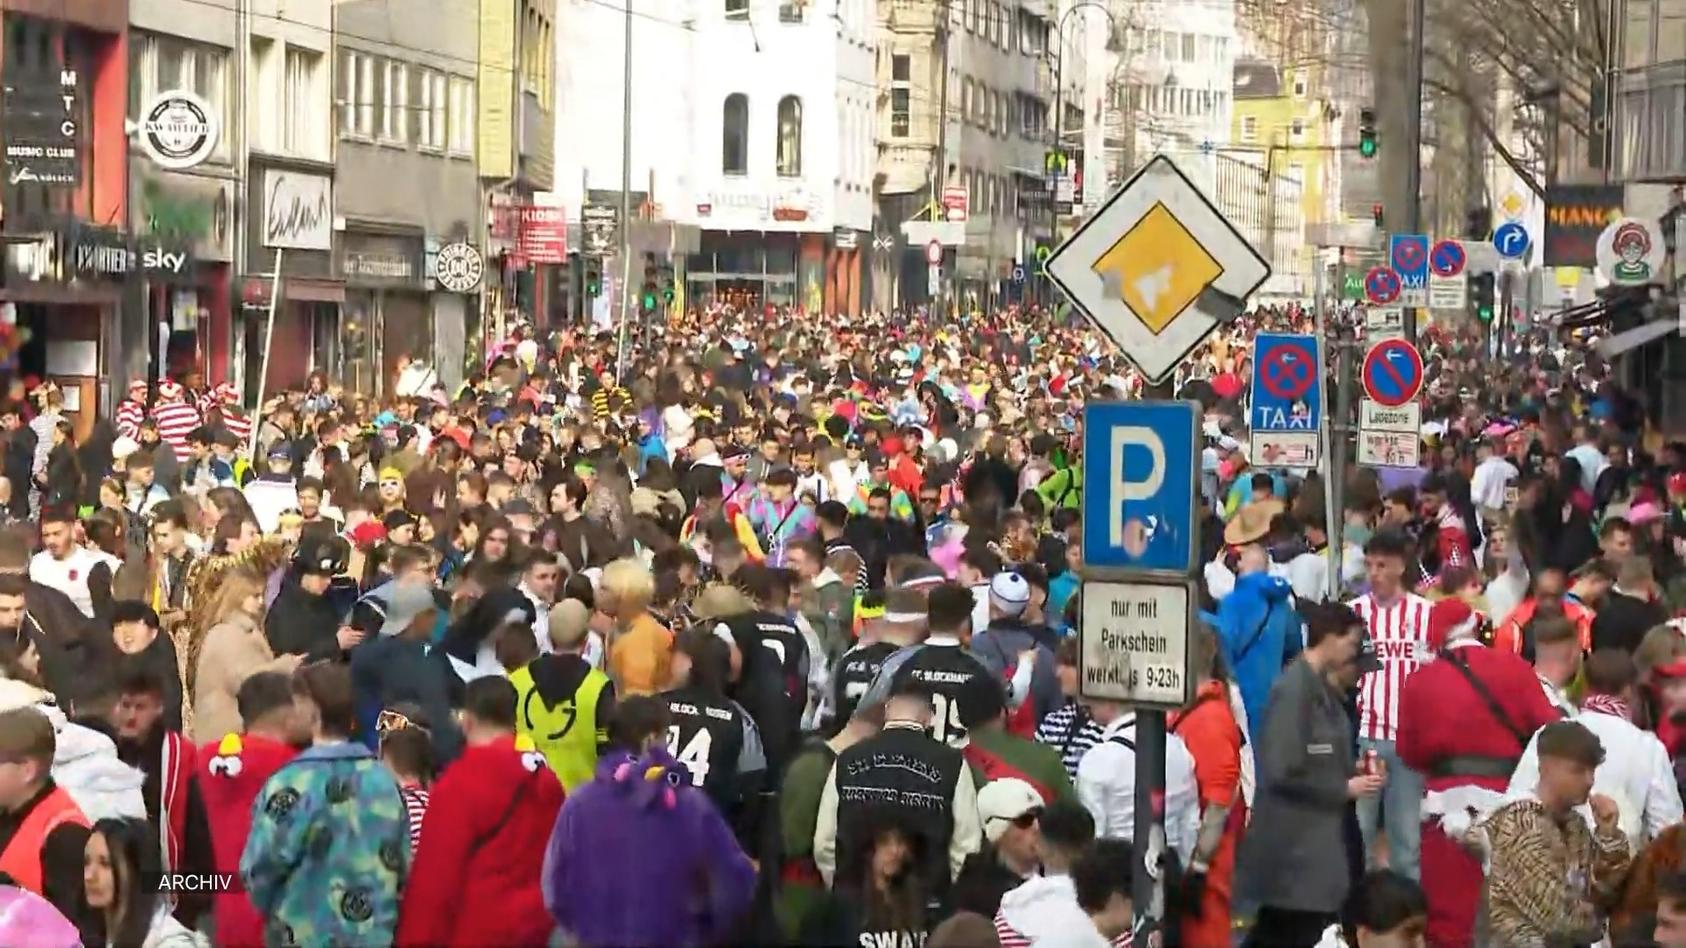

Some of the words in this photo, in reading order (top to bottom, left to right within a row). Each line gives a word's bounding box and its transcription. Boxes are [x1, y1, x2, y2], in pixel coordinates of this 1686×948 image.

[143, 248, 186, 273] sky
[1401, 274, 1425, 289] AXI
[1109, 424, 1167, 548] P
[1111, 599, 1130, 618] nur
[1138, 598, 1158, 618] mit
[1101, 627, 1167, 654] Parkschein
[1374, 641, 1414, 659] EWE
